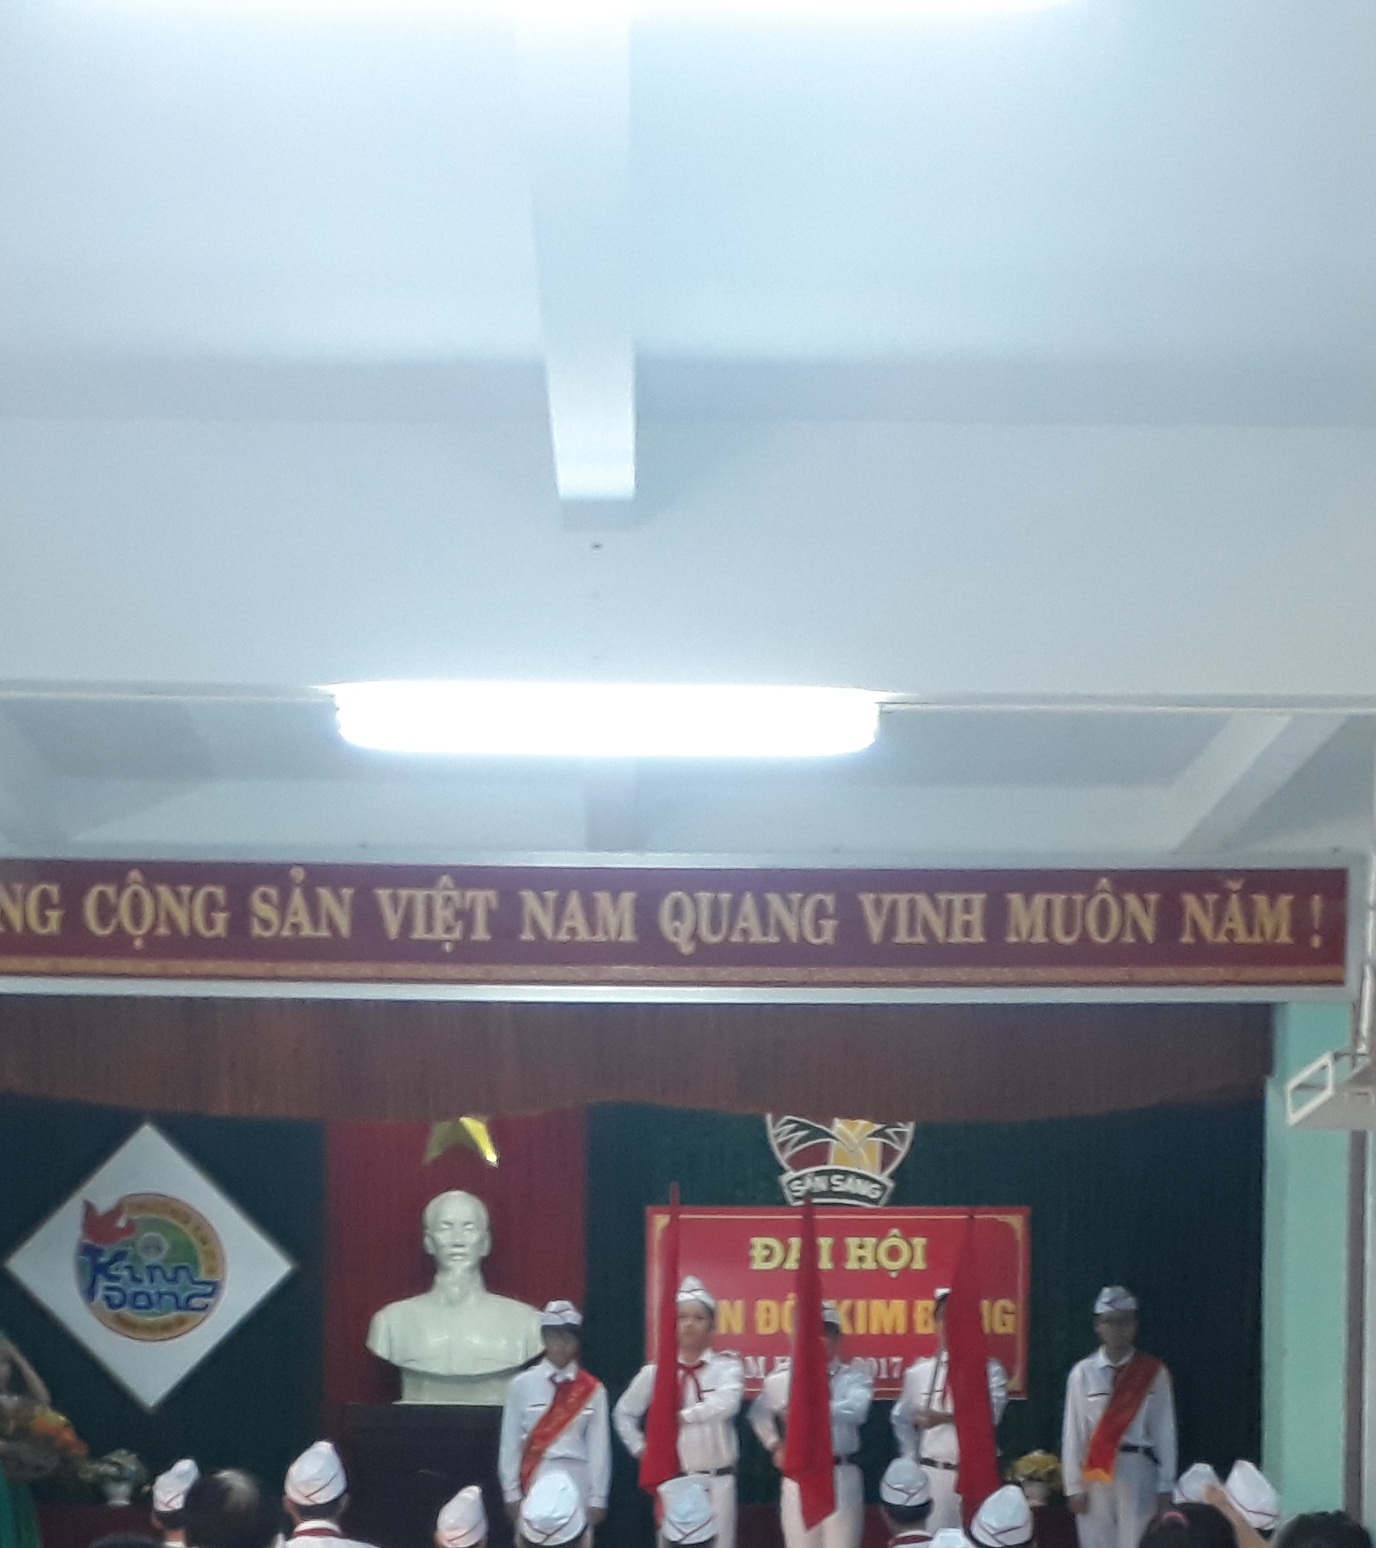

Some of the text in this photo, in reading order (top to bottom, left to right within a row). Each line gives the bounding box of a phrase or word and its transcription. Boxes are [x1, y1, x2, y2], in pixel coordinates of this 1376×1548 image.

[84, 868, 228, 950] CỘNG
[251, 865, 354, 940] SẢN
[375, 874, 498, 953] VIỆT
[520, 889, 637, 942] NAM
[658, 890, 840, 955] QUANG
[859, 892, 985, 946] VINH
[1005, 877, 1160, 946] MUÔN
[843, 1227, 928, 1279] HỘI
